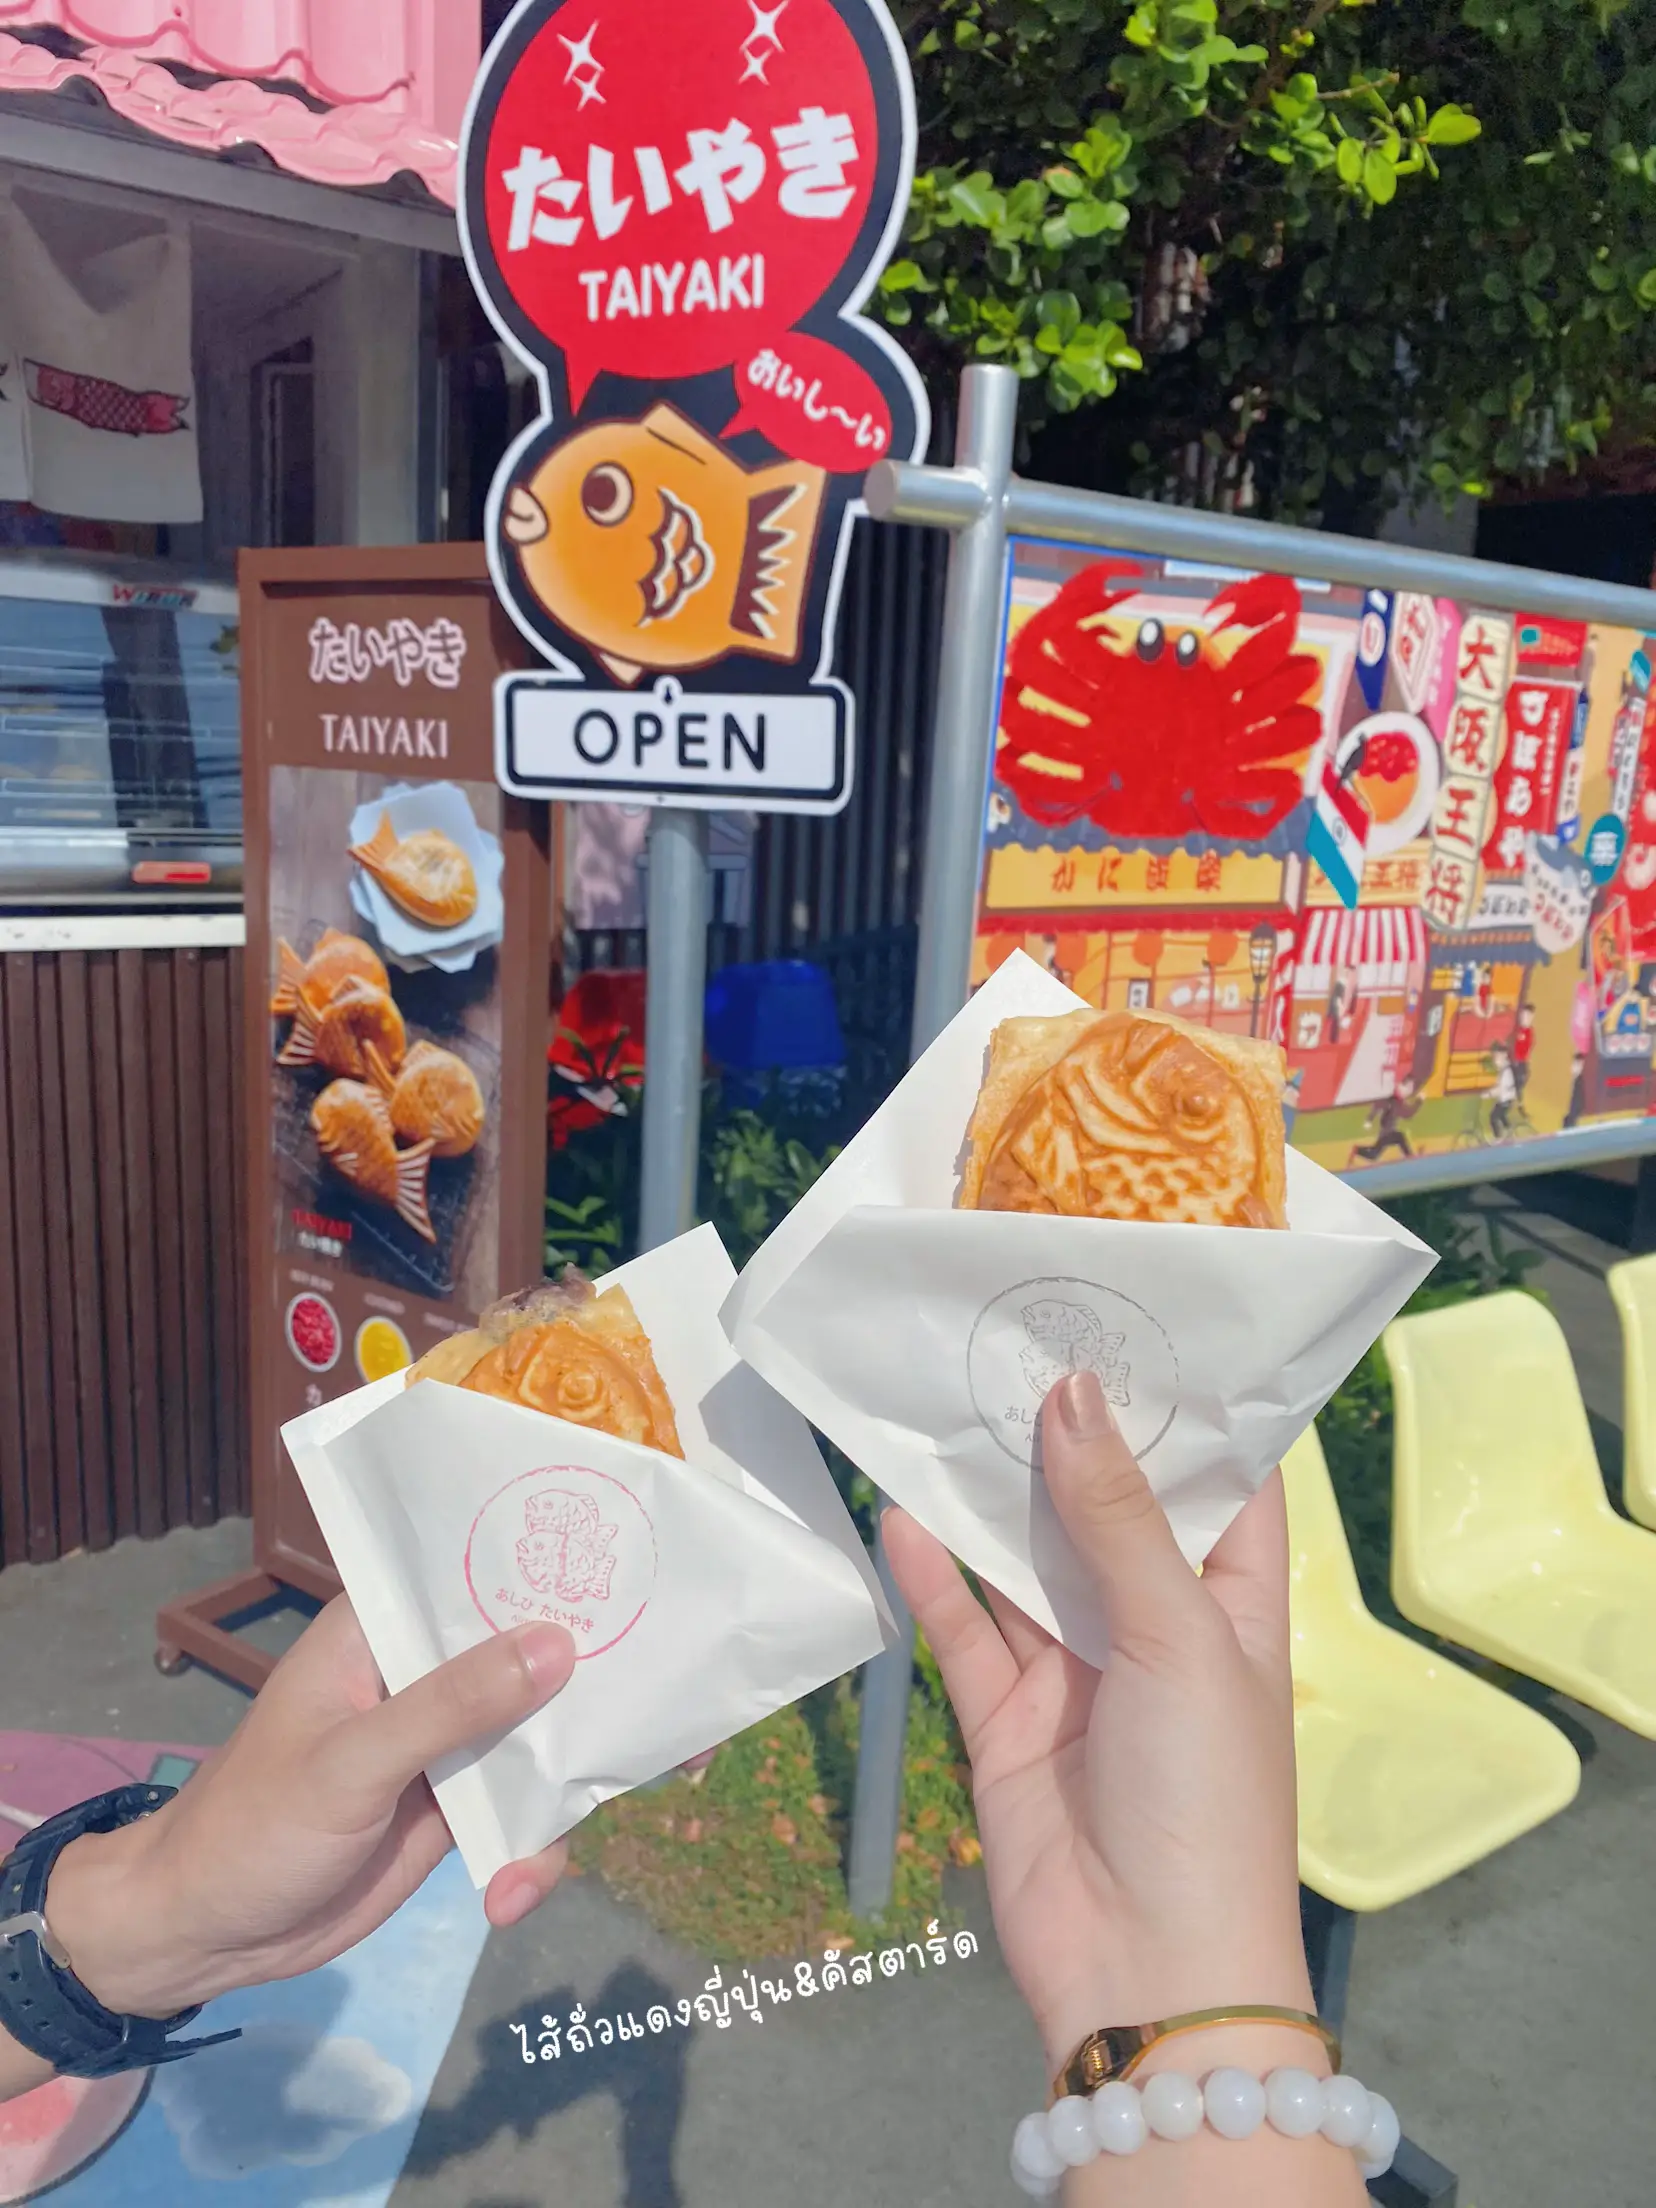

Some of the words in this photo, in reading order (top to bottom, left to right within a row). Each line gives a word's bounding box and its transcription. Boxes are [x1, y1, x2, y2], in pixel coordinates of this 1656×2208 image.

[502, 106, 860, 252] たいやき
[579, 254, 765, 322] TAIYAKI
[308, 616, 467, 689] たいやき
[320, 713, 449, 759] TAIYAKI
[573, 709, 766, 772] OPEN
